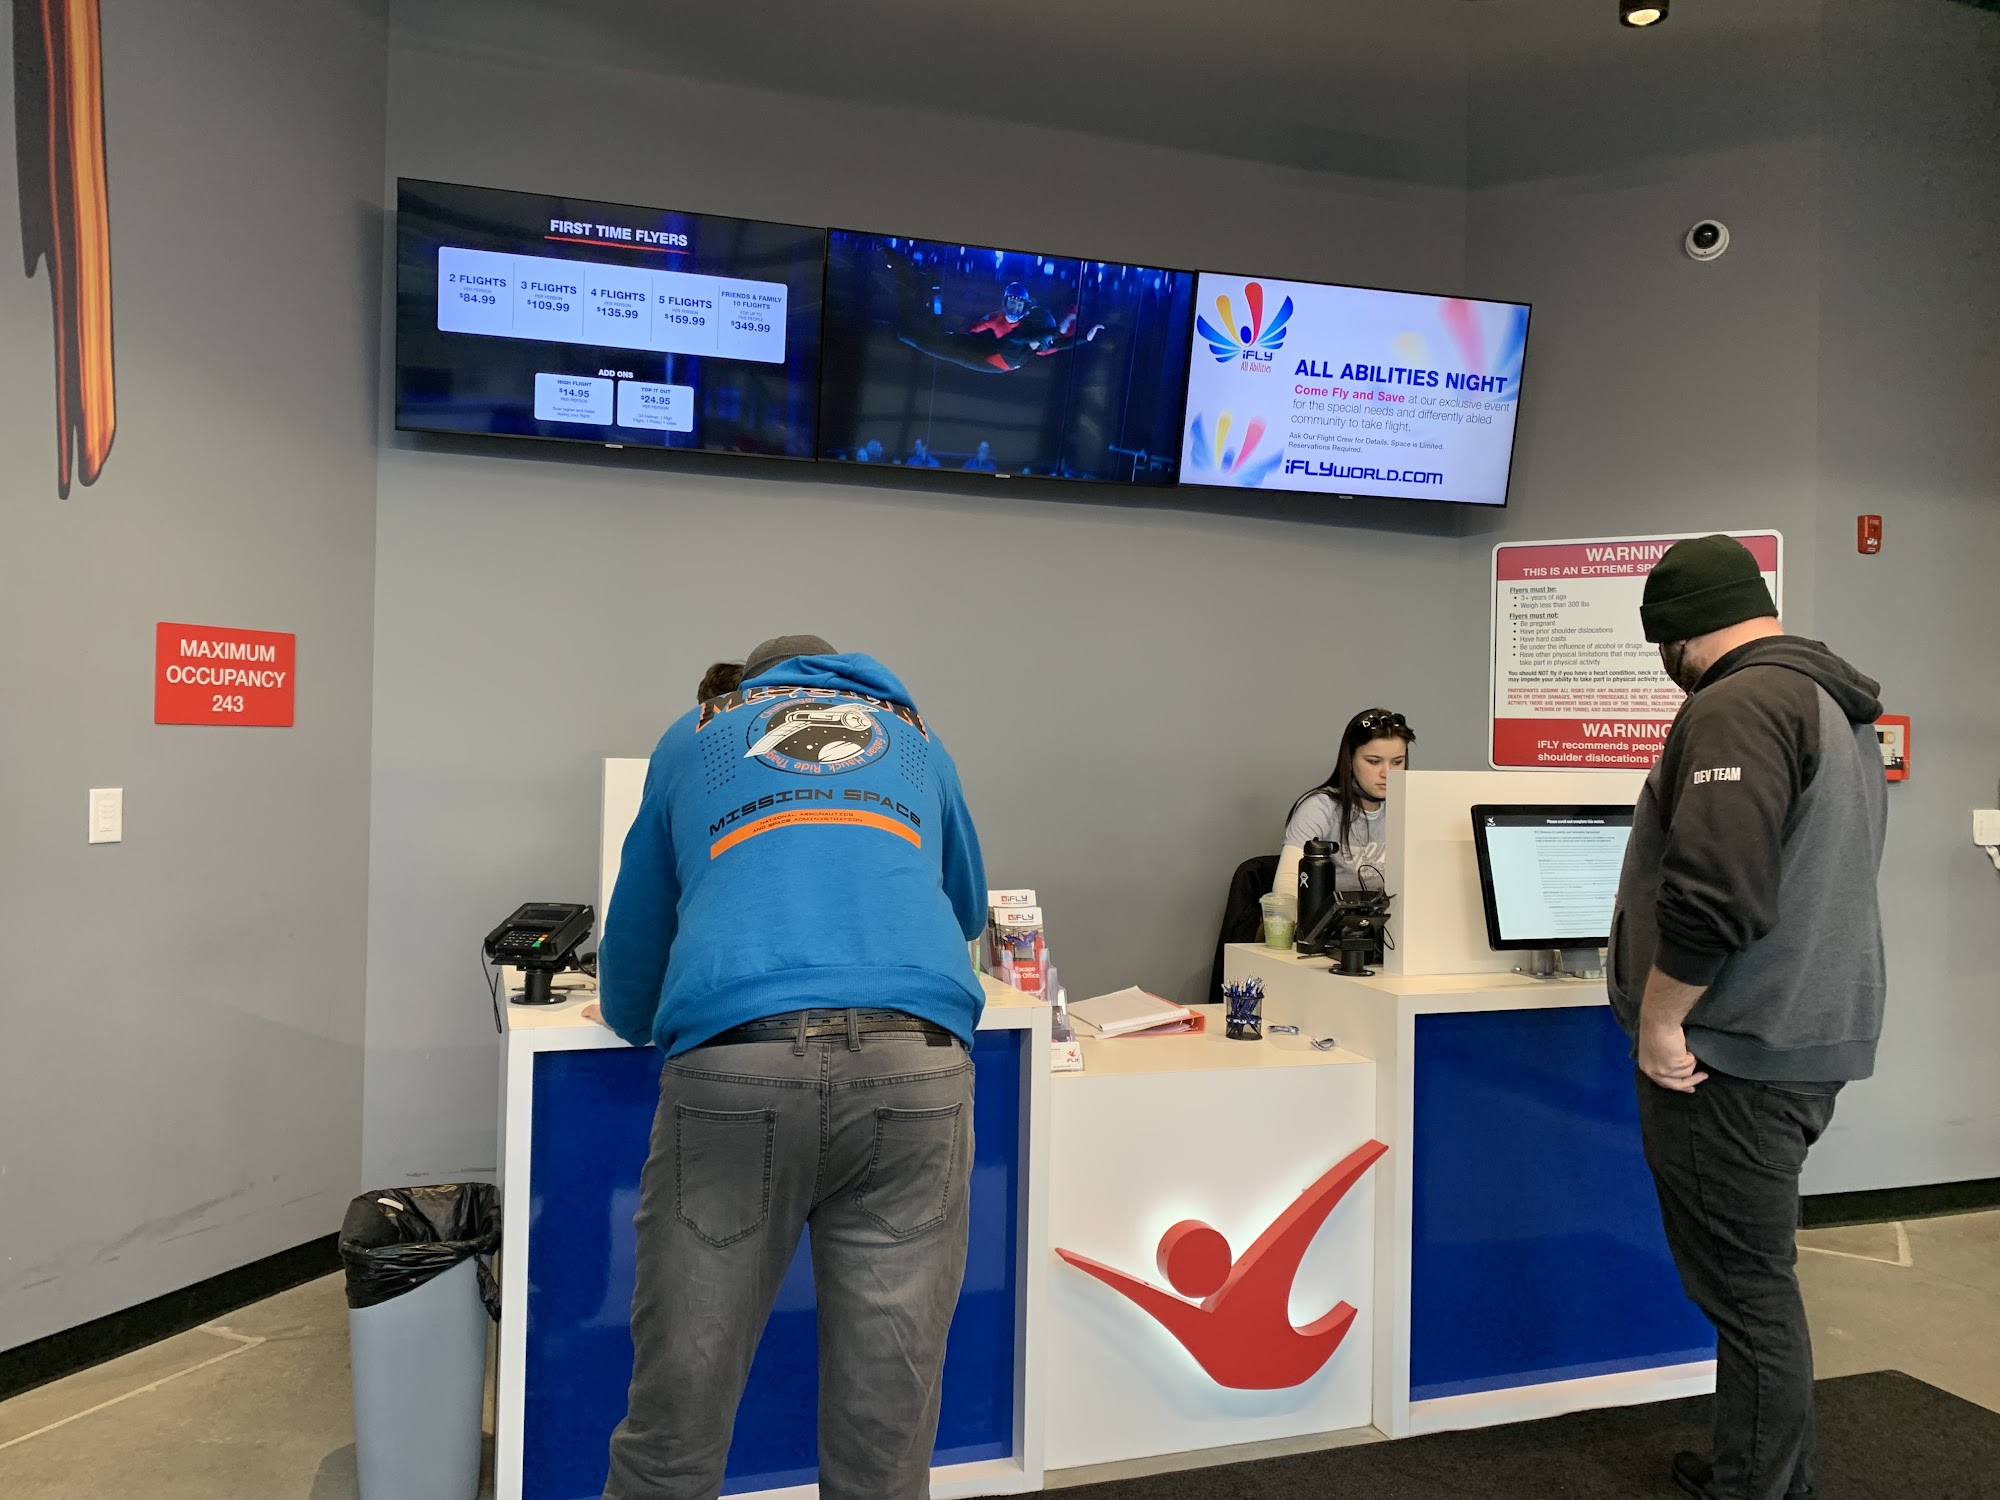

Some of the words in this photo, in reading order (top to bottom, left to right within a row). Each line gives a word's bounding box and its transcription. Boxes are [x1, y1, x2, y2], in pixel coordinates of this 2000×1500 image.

[550, 219, 593, 236] FIRST
[596, 224, 632, 241] TIME
[636, 230, 688, 247] FLYERS
[449, 273, 456, 283] 2
[459, 275, 507, 288] FLIGHTS
[521, 281, 528, 290] 3
[531, 282, 577, 295] FLIGHTS
[459, 292, 496, 305] $84.99
[590, 288, 597, 297] 4
[600, 289, 646, 302] FLIGHTS
[721, 291, 751, 300] FRIENDS
[758, 295, 782, 303] FAMILY
[527, 299, 570, 313] $109.99
[658, 295, 665, 304] 5
[669, 296, 712, 309] FLIGHTS
[742, 301, 771, 310] FLIGHTS
[596, 306, 639, 319] $135.99
[665, 313, 706, 326] $159.99
[731, 320, 771, 333] $349.99
[598, 368, 615, 377] ADD
[617, 370, 634, 379] ONS
[1240, 361, 1249, 372] All
[1249, 362, 1272, 374] Abilities
[1294, 359, 1334, 379] ALL
[1340, 363, 1439, 388] ABILITIES
[1445, 372, 1508, 393] NIGHT
[559, 387, 590, 398] $14.95
[1294, 384, 1329, 397] Come
[1332, 387, 1350, 400] Fly
[1352, 390, 1374, 400] and
[1377, 391, 1405, 403] Save
[1408, 395, 1418, 404] at
[1420, 397, 1437, 406] our
[1438, 397, 1482, 410] exclusive
[1484, 402, 1510, 412] event
[641, 395, 671, 405] $24.95
[1293, 399, 1306, 410] for
[1309, 400, 1325, 411] the
[1327, 401, 1361, 414] special
[1364, 405, 1394, 416] needs
[1396, 408, 1415, 418] and
[1418, 409, 1463, 424] differently
[1466, 413, 1492, 424] abled
[1291, 414, 1347, 429] community
[1349, 418, 1358, 428] to
[1361, 418, 1382, 430] take
[1385, 420, 1411, 433] flight.
[1288, 441, 1330, 451] Reservations
[1332, 444, 1363, 454] Required.
[1289, 432, 1301, 440] Ask
[1303, 433, 1315, 441] Our
[1316, 433, 1335, 443] Flight
[1336, 435, 1353, 443] Crew
[1355, 436, 1364, 444] for
[1365, 437, 1389, 446] Details.
[1391, 440, 1411, 449] Space
[1419, 442, 1444, 450] Limited.
[1523, 567, 1548, 577] THIS
[1550, 566, 1561, 576] IS
[1563, 566, 1578, 575] AN
[1581, 564, 1634, 575] EXTREME
[180, 638, 275, 663] MAXIMUM
[1552, 651, 1577, 659] physical
[1553, 659, 1578, 667] physical
[165, 664, 286, 689] OCCUPANCY
[211, 694, 244, 713] 243
[1537, 740, 1560, 750] iFLY
[1562, 741, 1629, 751] recommends
[1537, 752, 1583, 762] shoulder
[1585, 752, 1650, 763] dislocations
[793, 761, 821, 774] Ride
[827, 756, 867, 773] Hauck
[1693, 769, 1712, 785] DEV
[1713, 767, 1742, 782] TEAM
[708, 788, 834, 837] MISSION
[843, 788, 922, 828] SPACE
